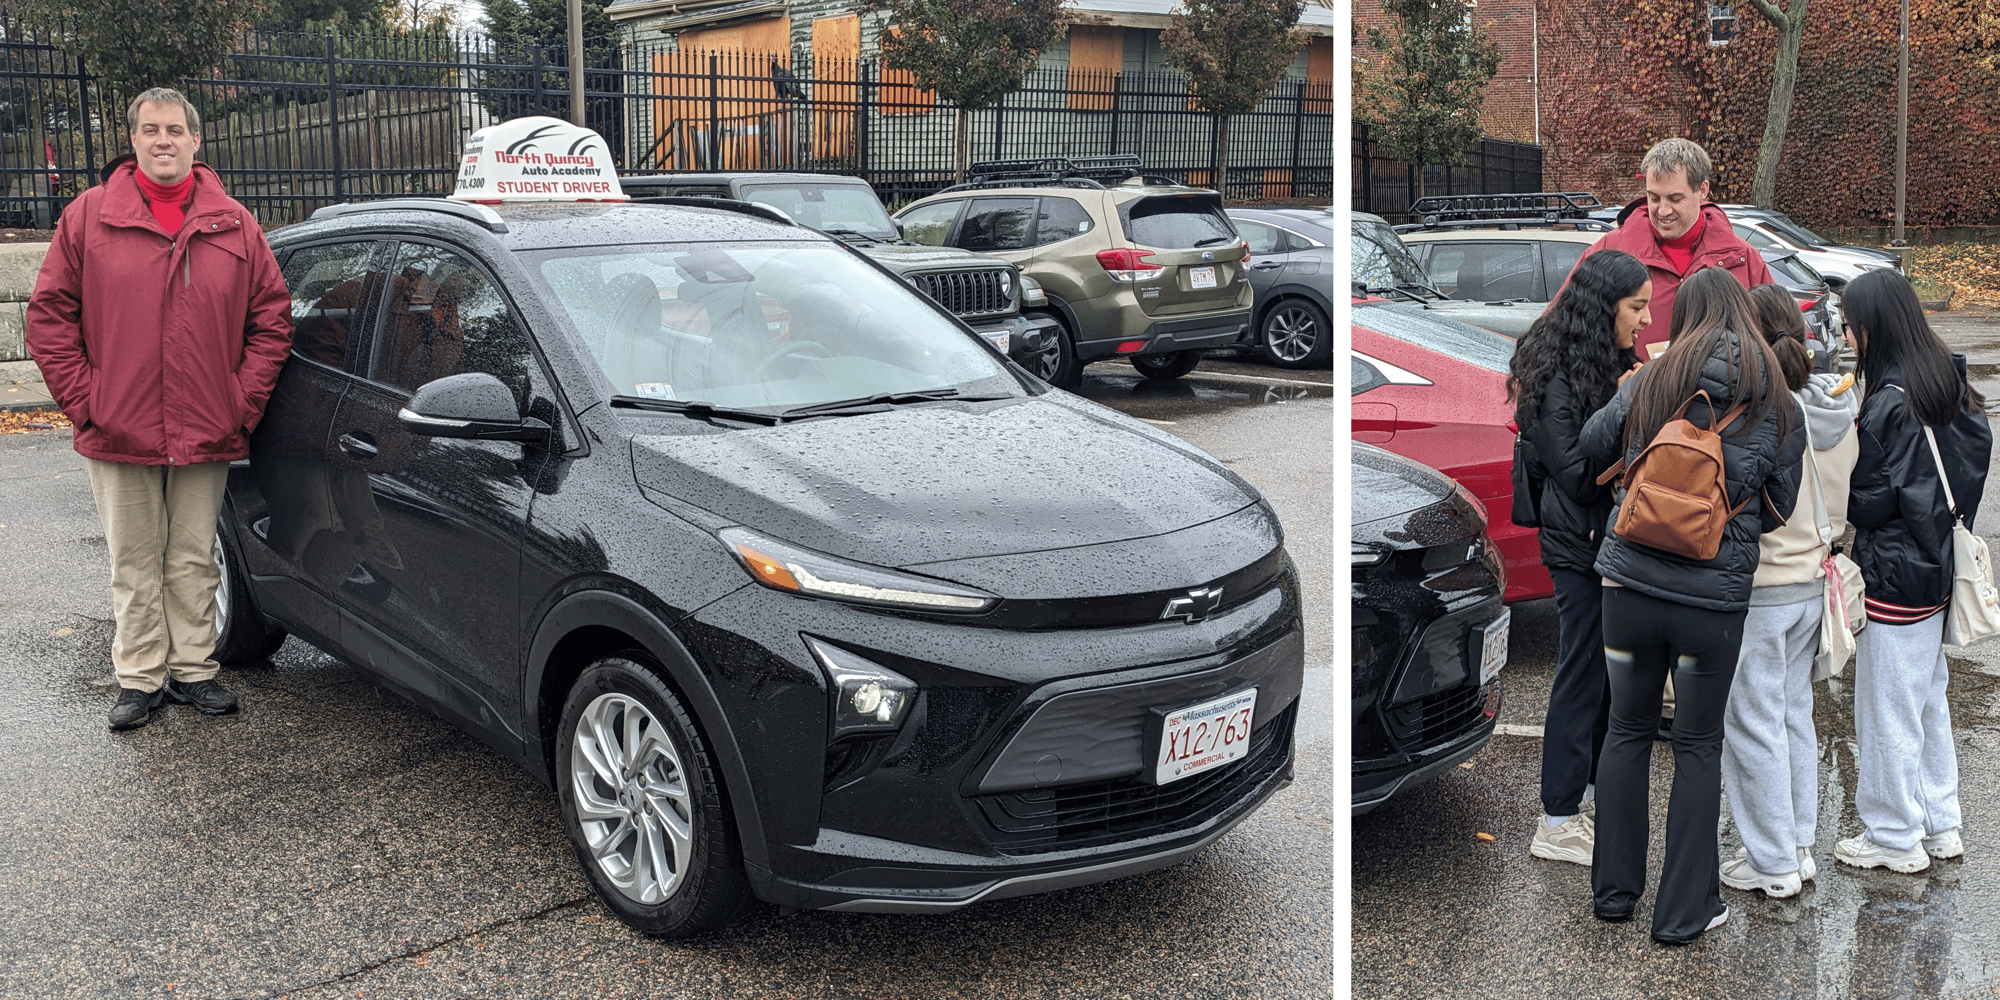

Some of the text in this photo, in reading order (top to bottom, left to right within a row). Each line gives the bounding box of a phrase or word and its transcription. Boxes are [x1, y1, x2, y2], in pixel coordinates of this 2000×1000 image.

[495, 150, 595, 167] North Quincy
[464, 165, 476, 176] 617
[521, 166, 601, 176] Auto Academy
[497, 181, 611, 193] STUDENT DRIVER
[1169, 701, 1236, 727] DEC Massachusetts
[1183, 752, 1225, 771] COMMERCIAL
